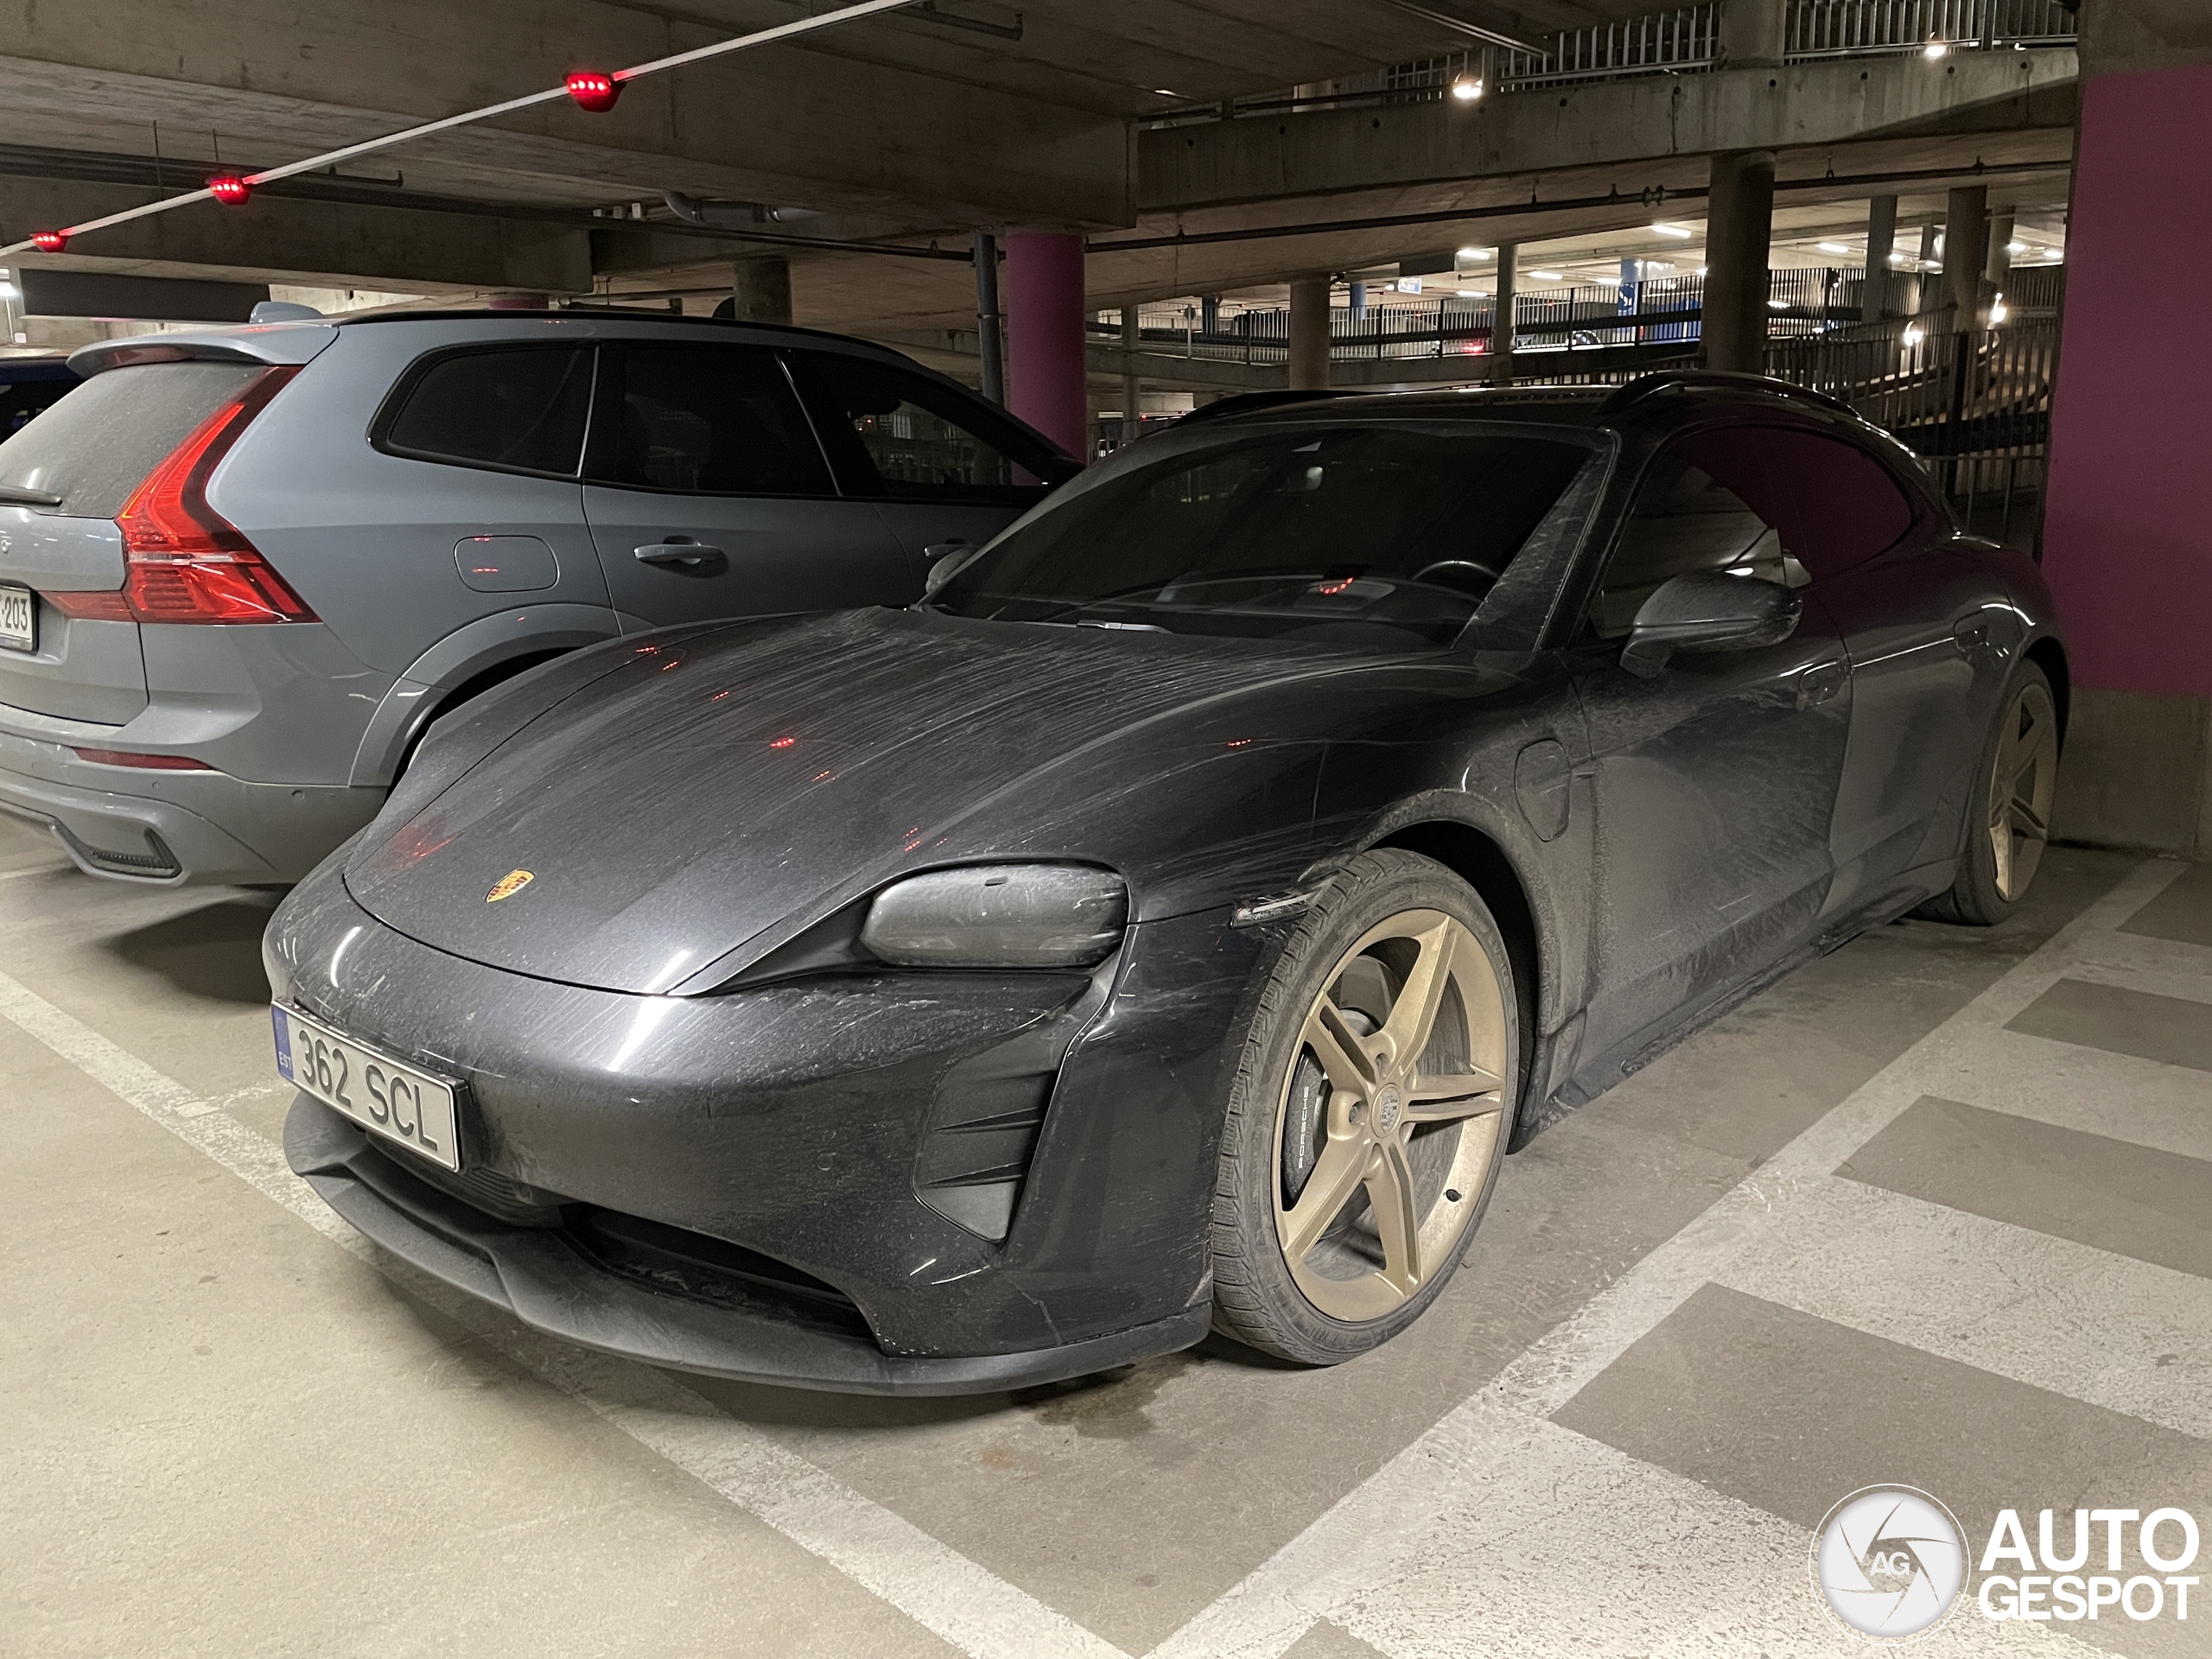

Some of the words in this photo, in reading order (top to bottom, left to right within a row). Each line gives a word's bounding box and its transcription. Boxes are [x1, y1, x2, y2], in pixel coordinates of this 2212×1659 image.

[278, 1052, 292, 1071] EST
[299, 1028, 352, 1109] 362
[365, 1064, 438, 1153] SCL
